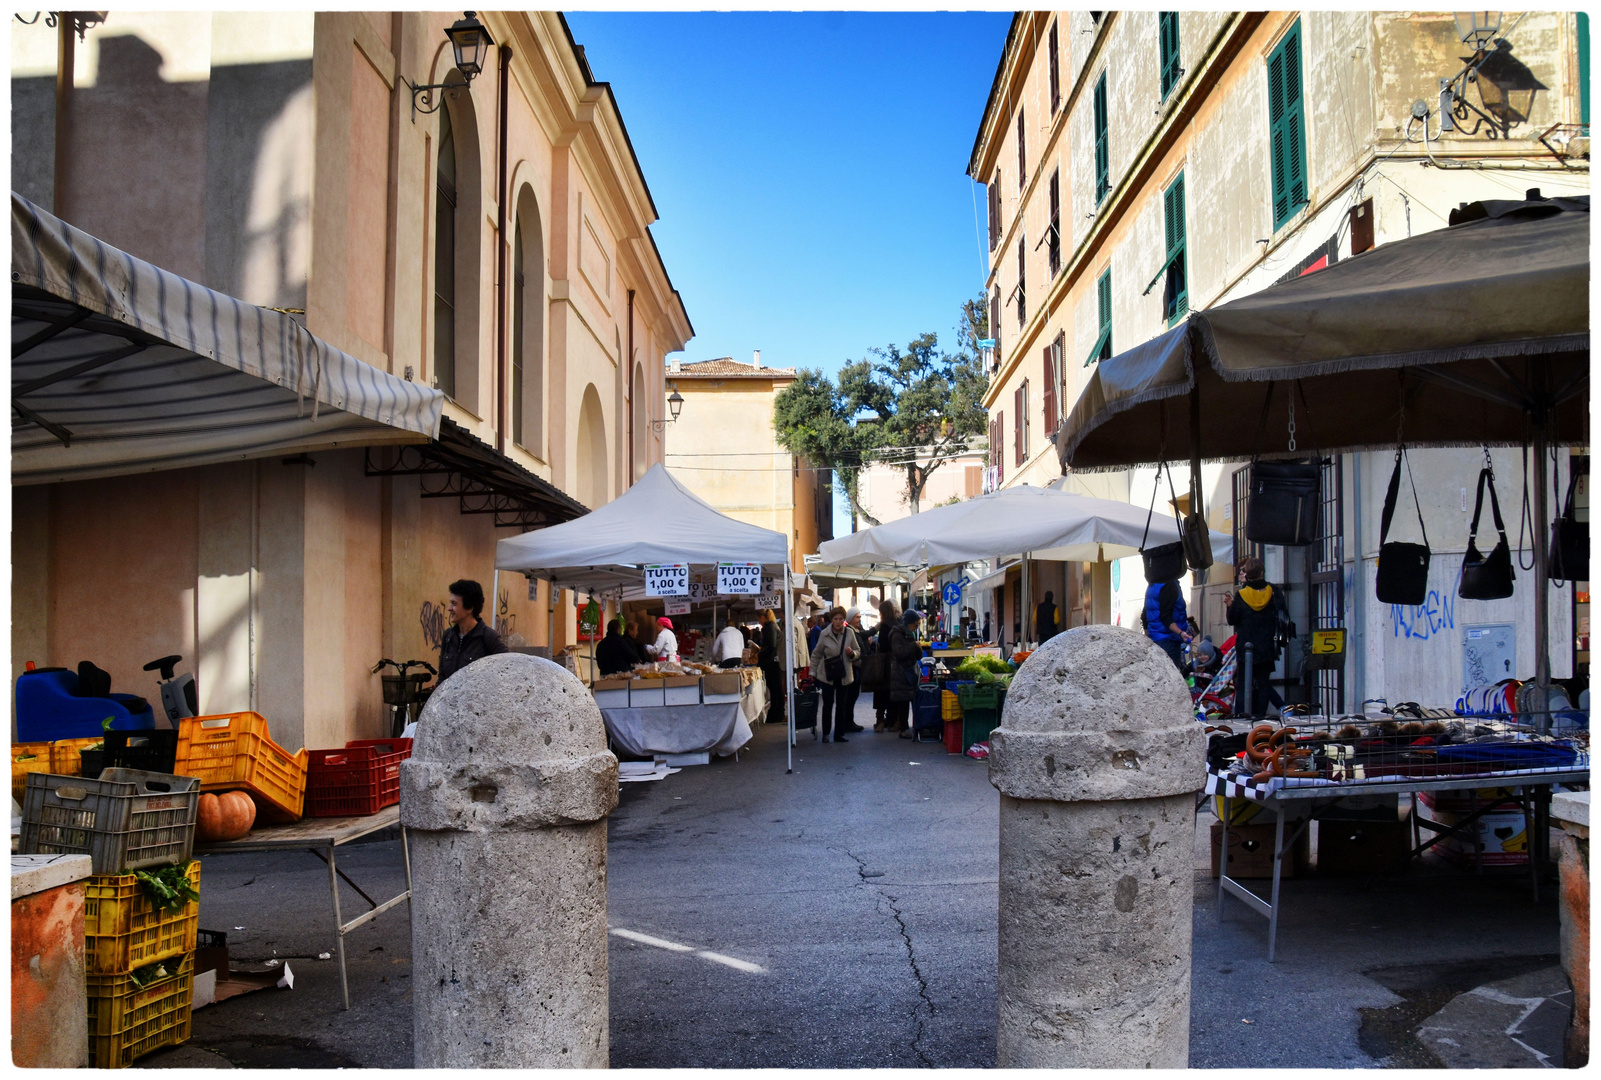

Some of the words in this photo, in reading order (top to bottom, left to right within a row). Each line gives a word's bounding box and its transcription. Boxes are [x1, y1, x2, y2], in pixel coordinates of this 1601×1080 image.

[647, 568, 687, 578] TUTTO
[719, 567, 760, 576] TUTTO
[650, 579, 674, 590] 1,00
[678, 578, 685, 587] €
[721, 577, 747, 588] 1,00
[750, 577, 757, 586] €
[1321, 637, 1337, 653] 5
